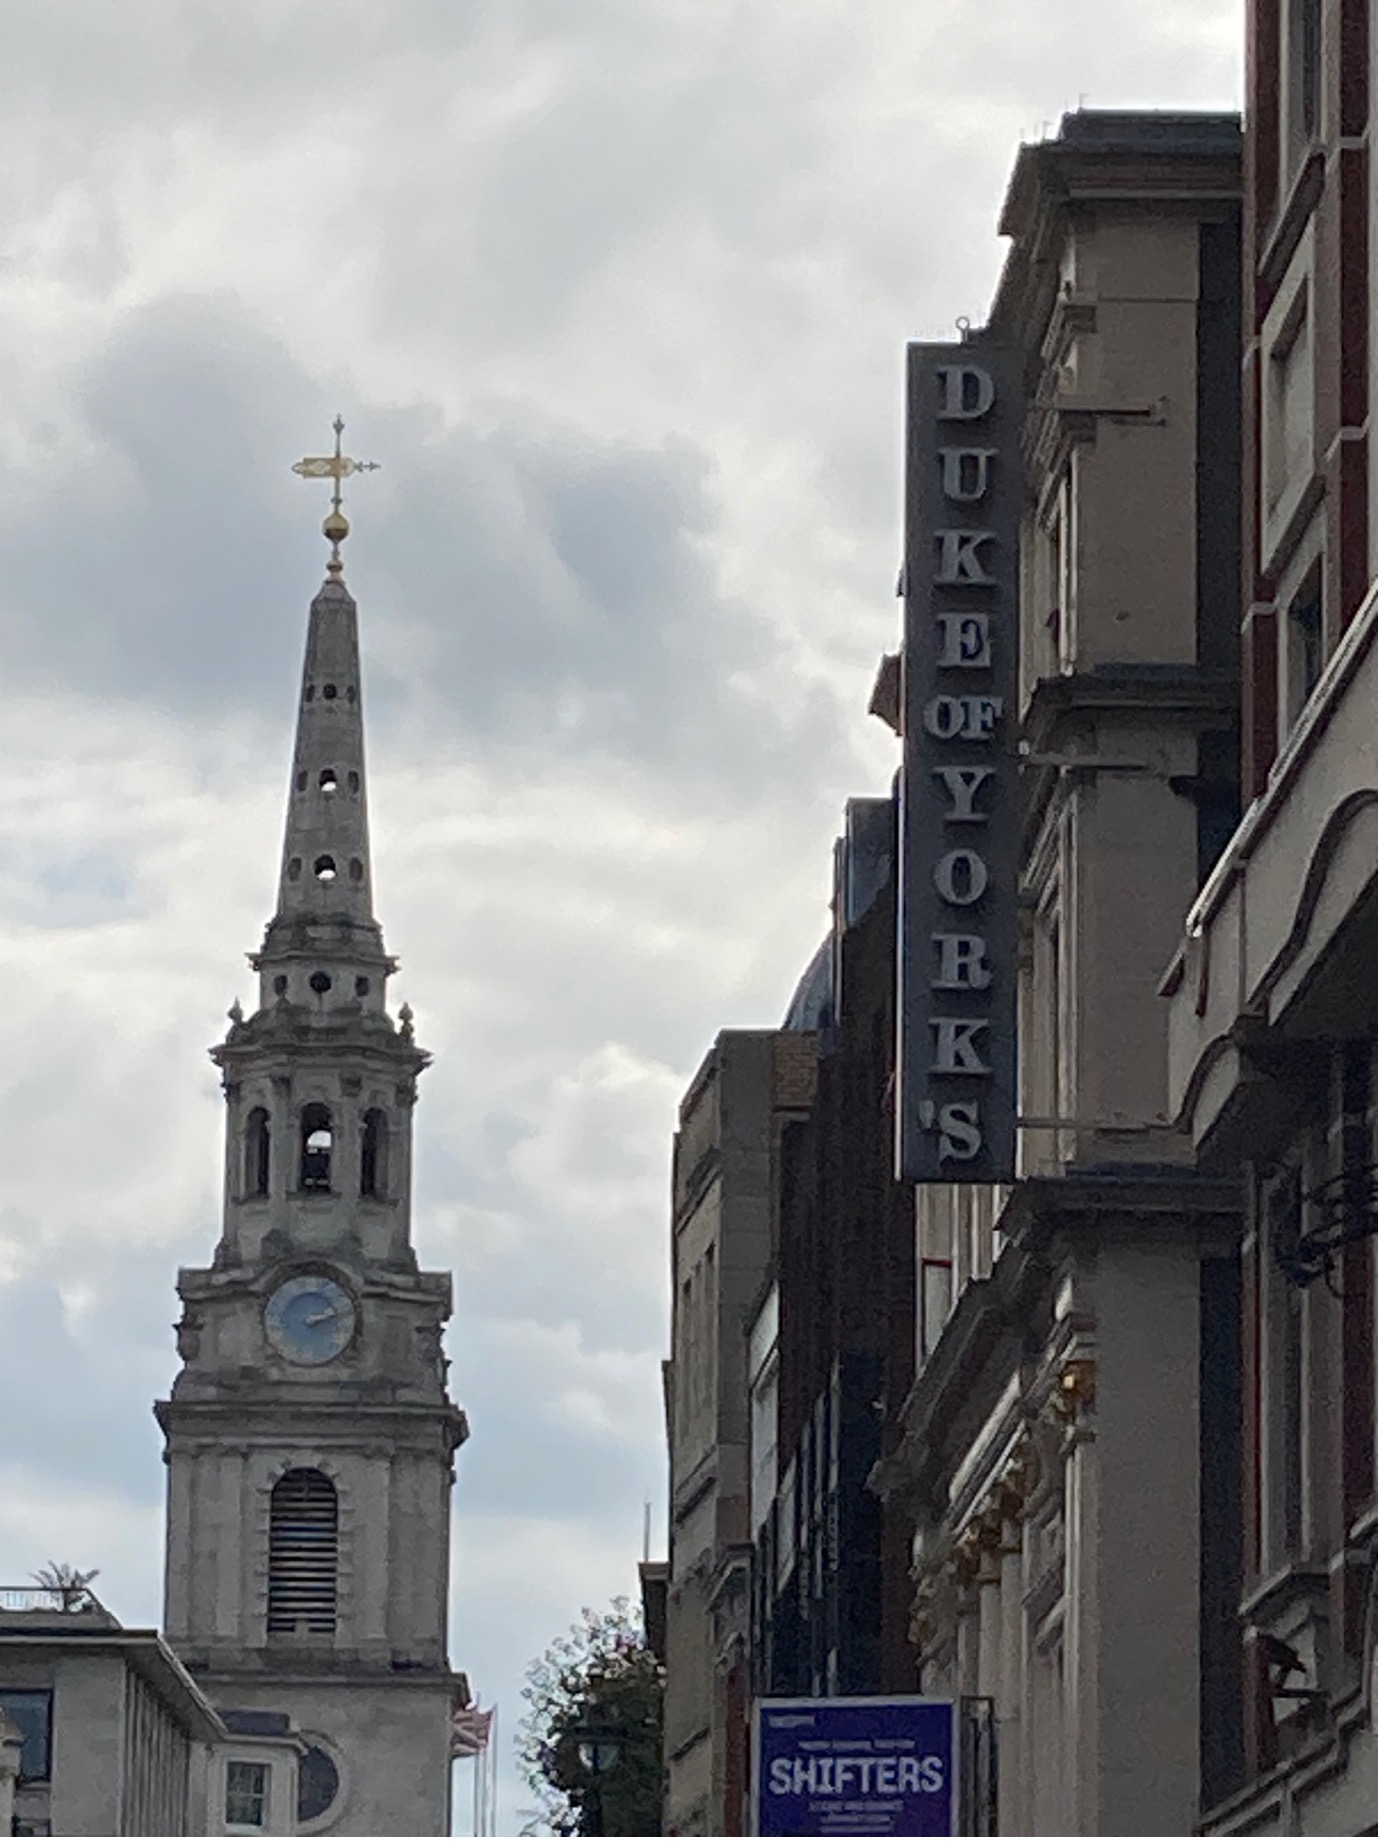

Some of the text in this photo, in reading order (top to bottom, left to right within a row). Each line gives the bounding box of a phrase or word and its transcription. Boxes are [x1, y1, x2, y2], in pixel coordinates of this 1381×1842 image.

[918, 364, 1003, 1161] DUKE OF YORK'S
[768, 1756, 944, 1795] SHIFTERS
